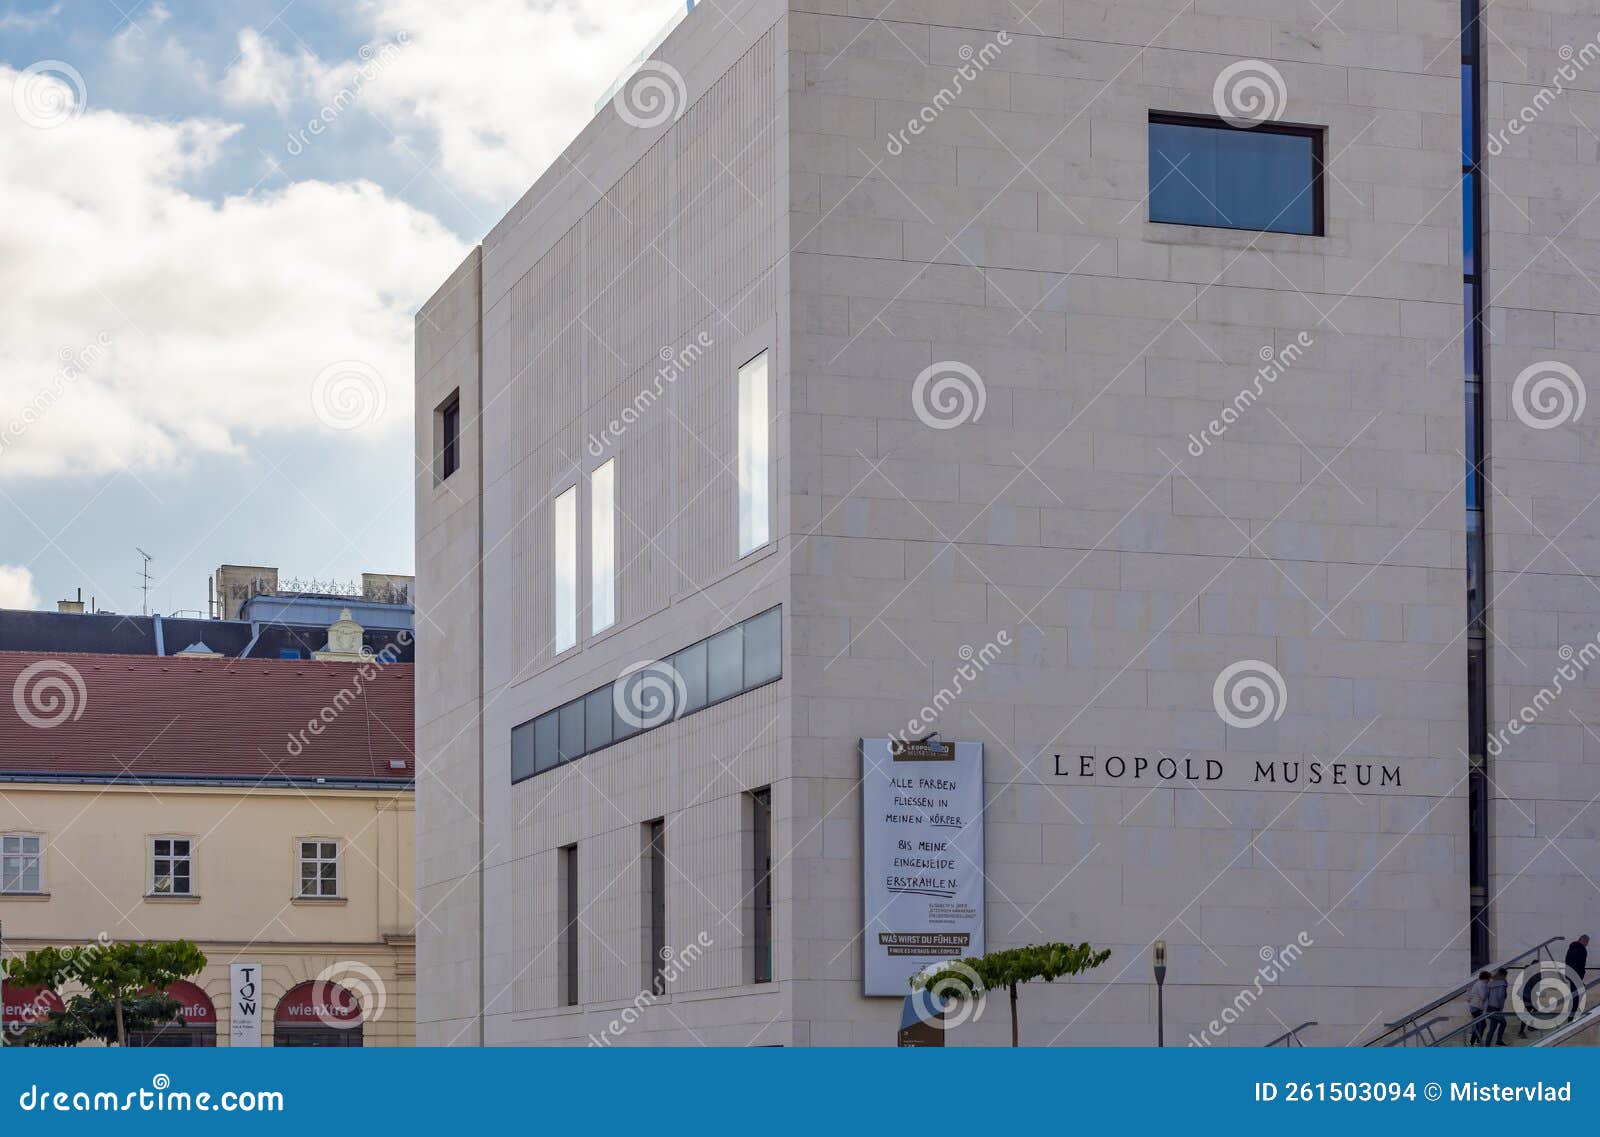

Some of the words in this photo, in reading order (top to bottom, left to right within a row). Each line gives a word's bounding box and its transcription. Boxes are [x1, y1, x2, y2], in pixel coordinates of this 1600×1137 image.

[1053, 754, 1223, 781] LEOPOLD
[1254, 760, 1402, 787] MUSEUM
[889, 778, 913, 789] ALLE
[919, 778, 957, 791] FARBEN
[894, 796, 934, 808] FLIESSEN
[938, 799, 948, 808] IN
[885, 813, 922, 824] MEINEN
[898, 839, 912, 851] BIS
[918, 841, 947, 852] MEINE
[893, 857, 955, 870] EINGEWEIDE
[881, 934, 897, 944] WAS
[898, 934, 920, 944] WIRST
[921, 935, 932, 945] DU
[933, 934, 968, 945] FÜHLEN?
[287, 1003, 350, 1016] wienXtra
